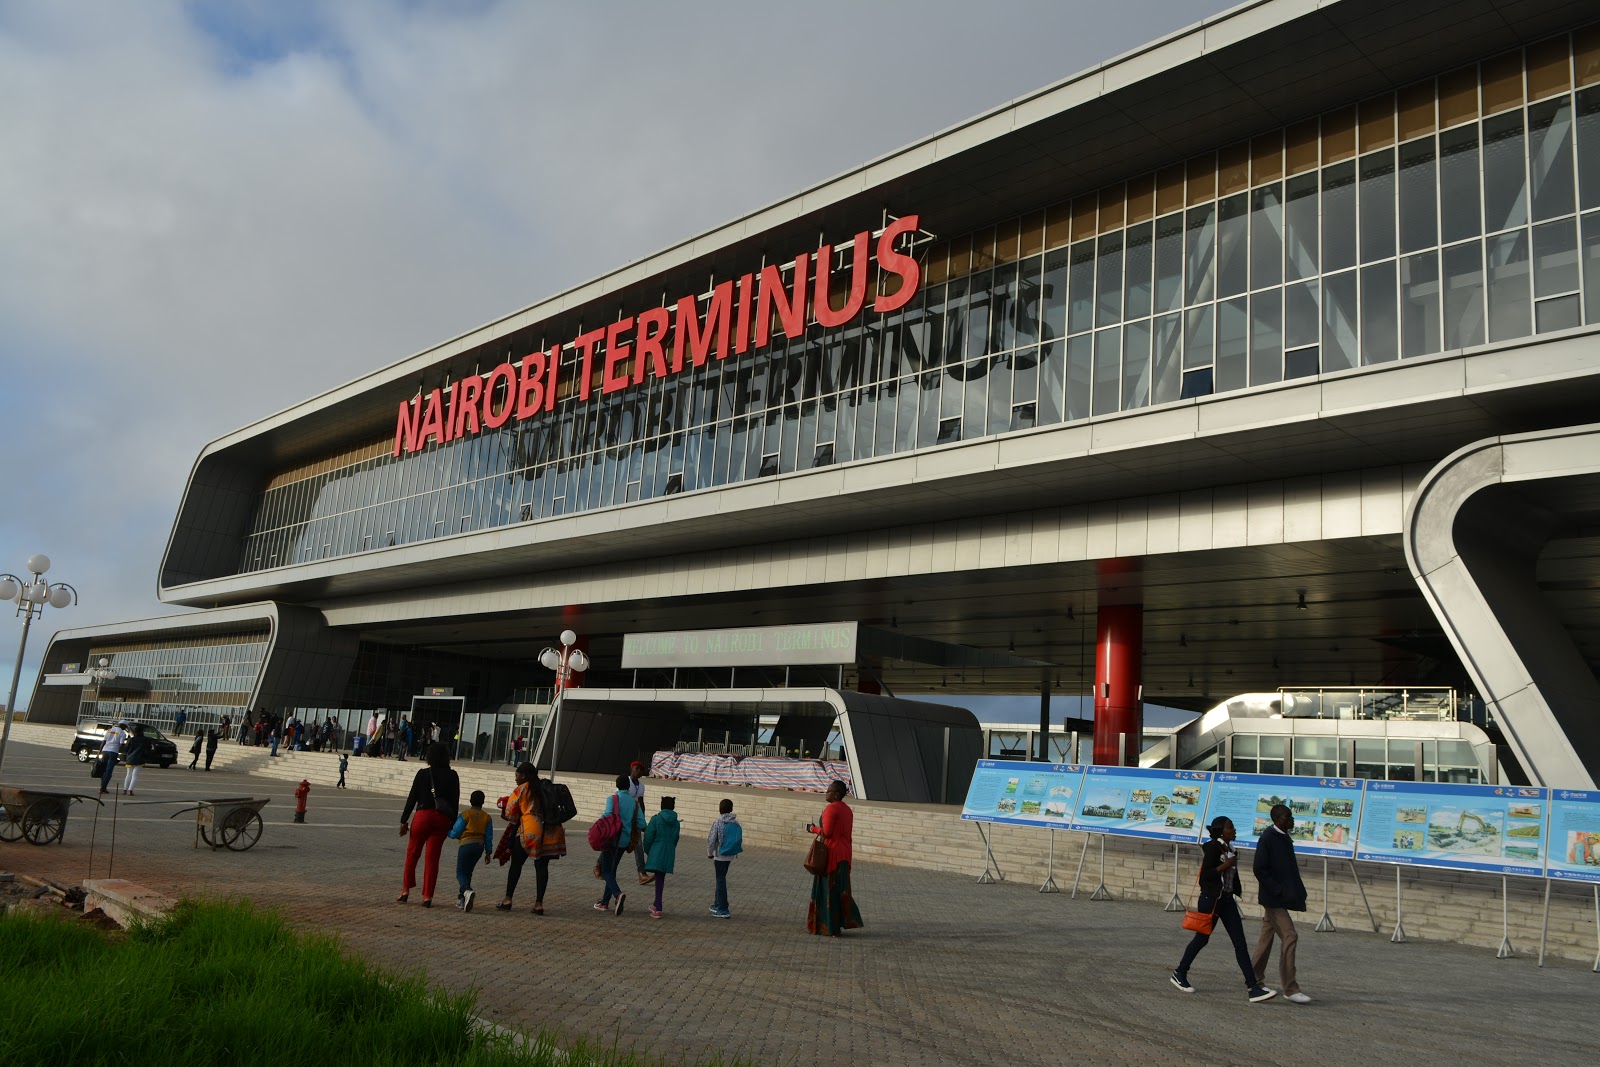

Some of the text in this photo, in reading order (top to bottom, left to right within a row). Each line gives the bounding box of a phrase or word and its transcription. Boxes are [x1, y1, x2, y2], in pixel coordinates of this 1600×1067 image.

[393, 214, 921, 457] NAIROBI TERMINUS
[624, 627, 851, 656] WELCOME TO NAIROBI TERMINUS
